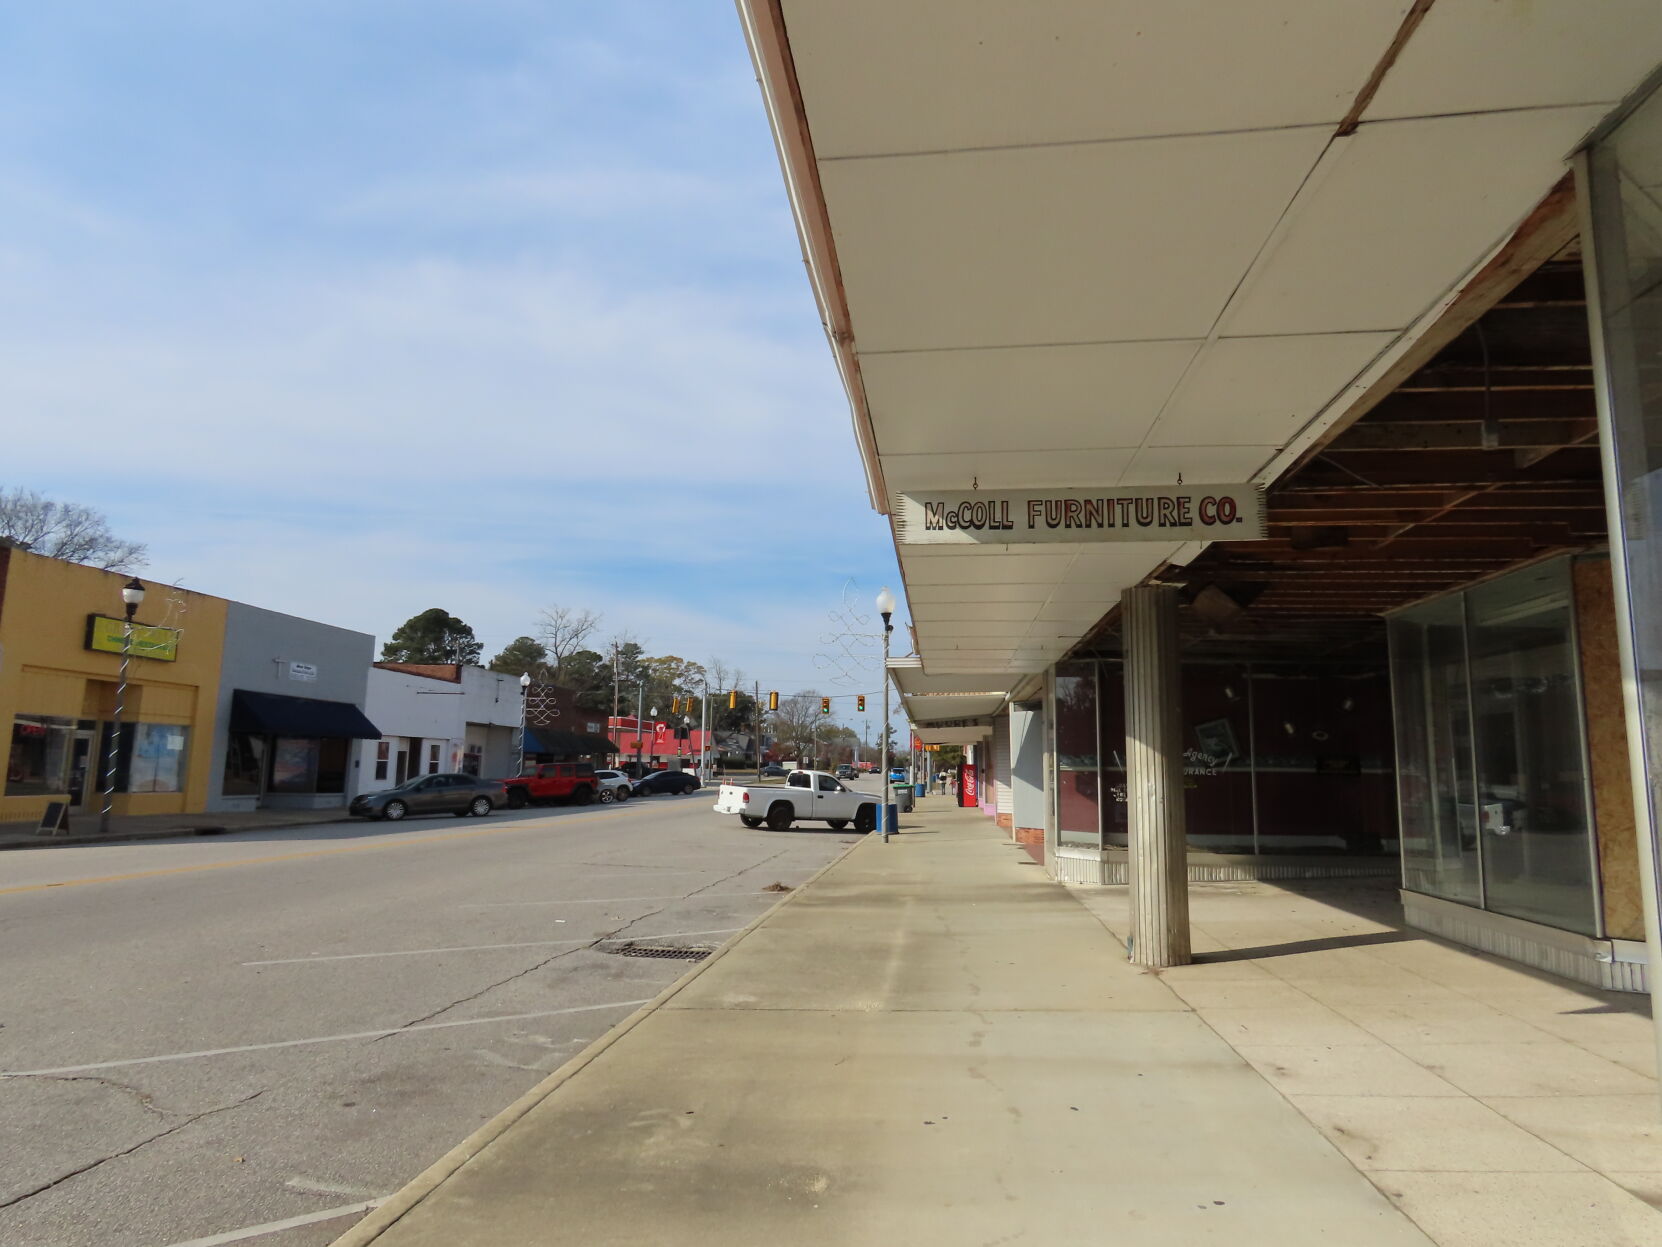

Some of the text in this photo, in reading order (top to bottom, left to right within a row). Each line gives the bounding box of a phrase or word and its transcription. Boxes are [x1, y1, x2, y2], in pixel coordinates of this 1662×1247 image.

[925, 495, 1243, 531] McCOLL FURNITURE CO.
[1182, 747, 1217, 767] Agency
[1183, 767, 1217, 776] URANCE
